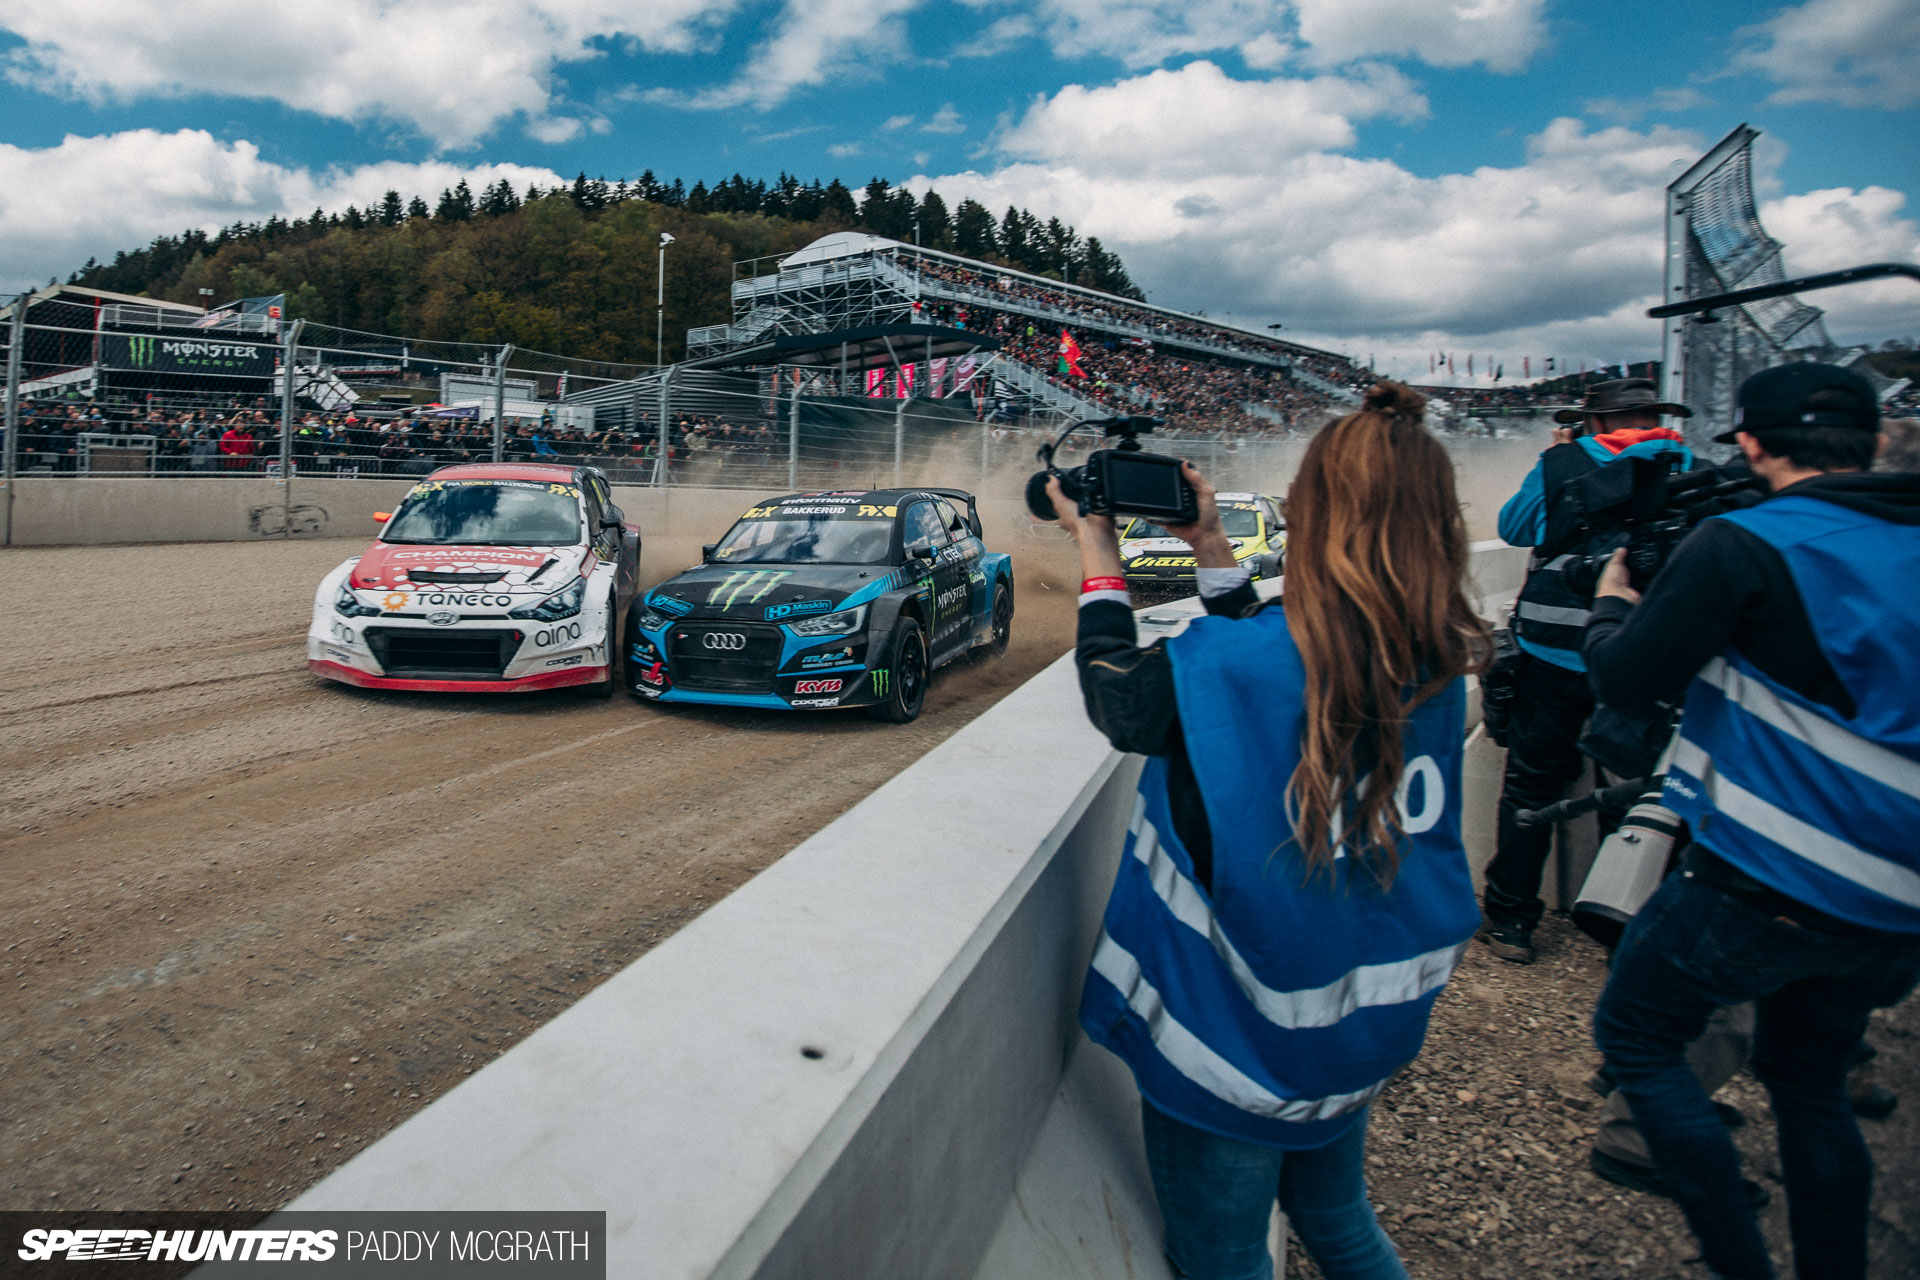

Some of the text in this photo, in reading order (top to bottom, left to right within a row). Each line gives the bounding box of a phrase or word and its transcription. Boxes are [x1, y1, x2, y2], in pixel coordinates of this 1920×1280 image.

[162, 341, 259, 359] MONSTER
[177, 358, 245, 367] ENERGY
[493, 481, 545, 490] RALLYCROSS
[782, 506, 847, 515] BAKKERUD
[394, 551, 539, 561] CHAMPION
[716, 548, 733, 559] 13
[416, 593, 511, 607] TANECO
[938, 584, 967, 609] MONSTER
[768, 602, 829, 618] HD Maskin
[794, 678, 843, 694] KYB
